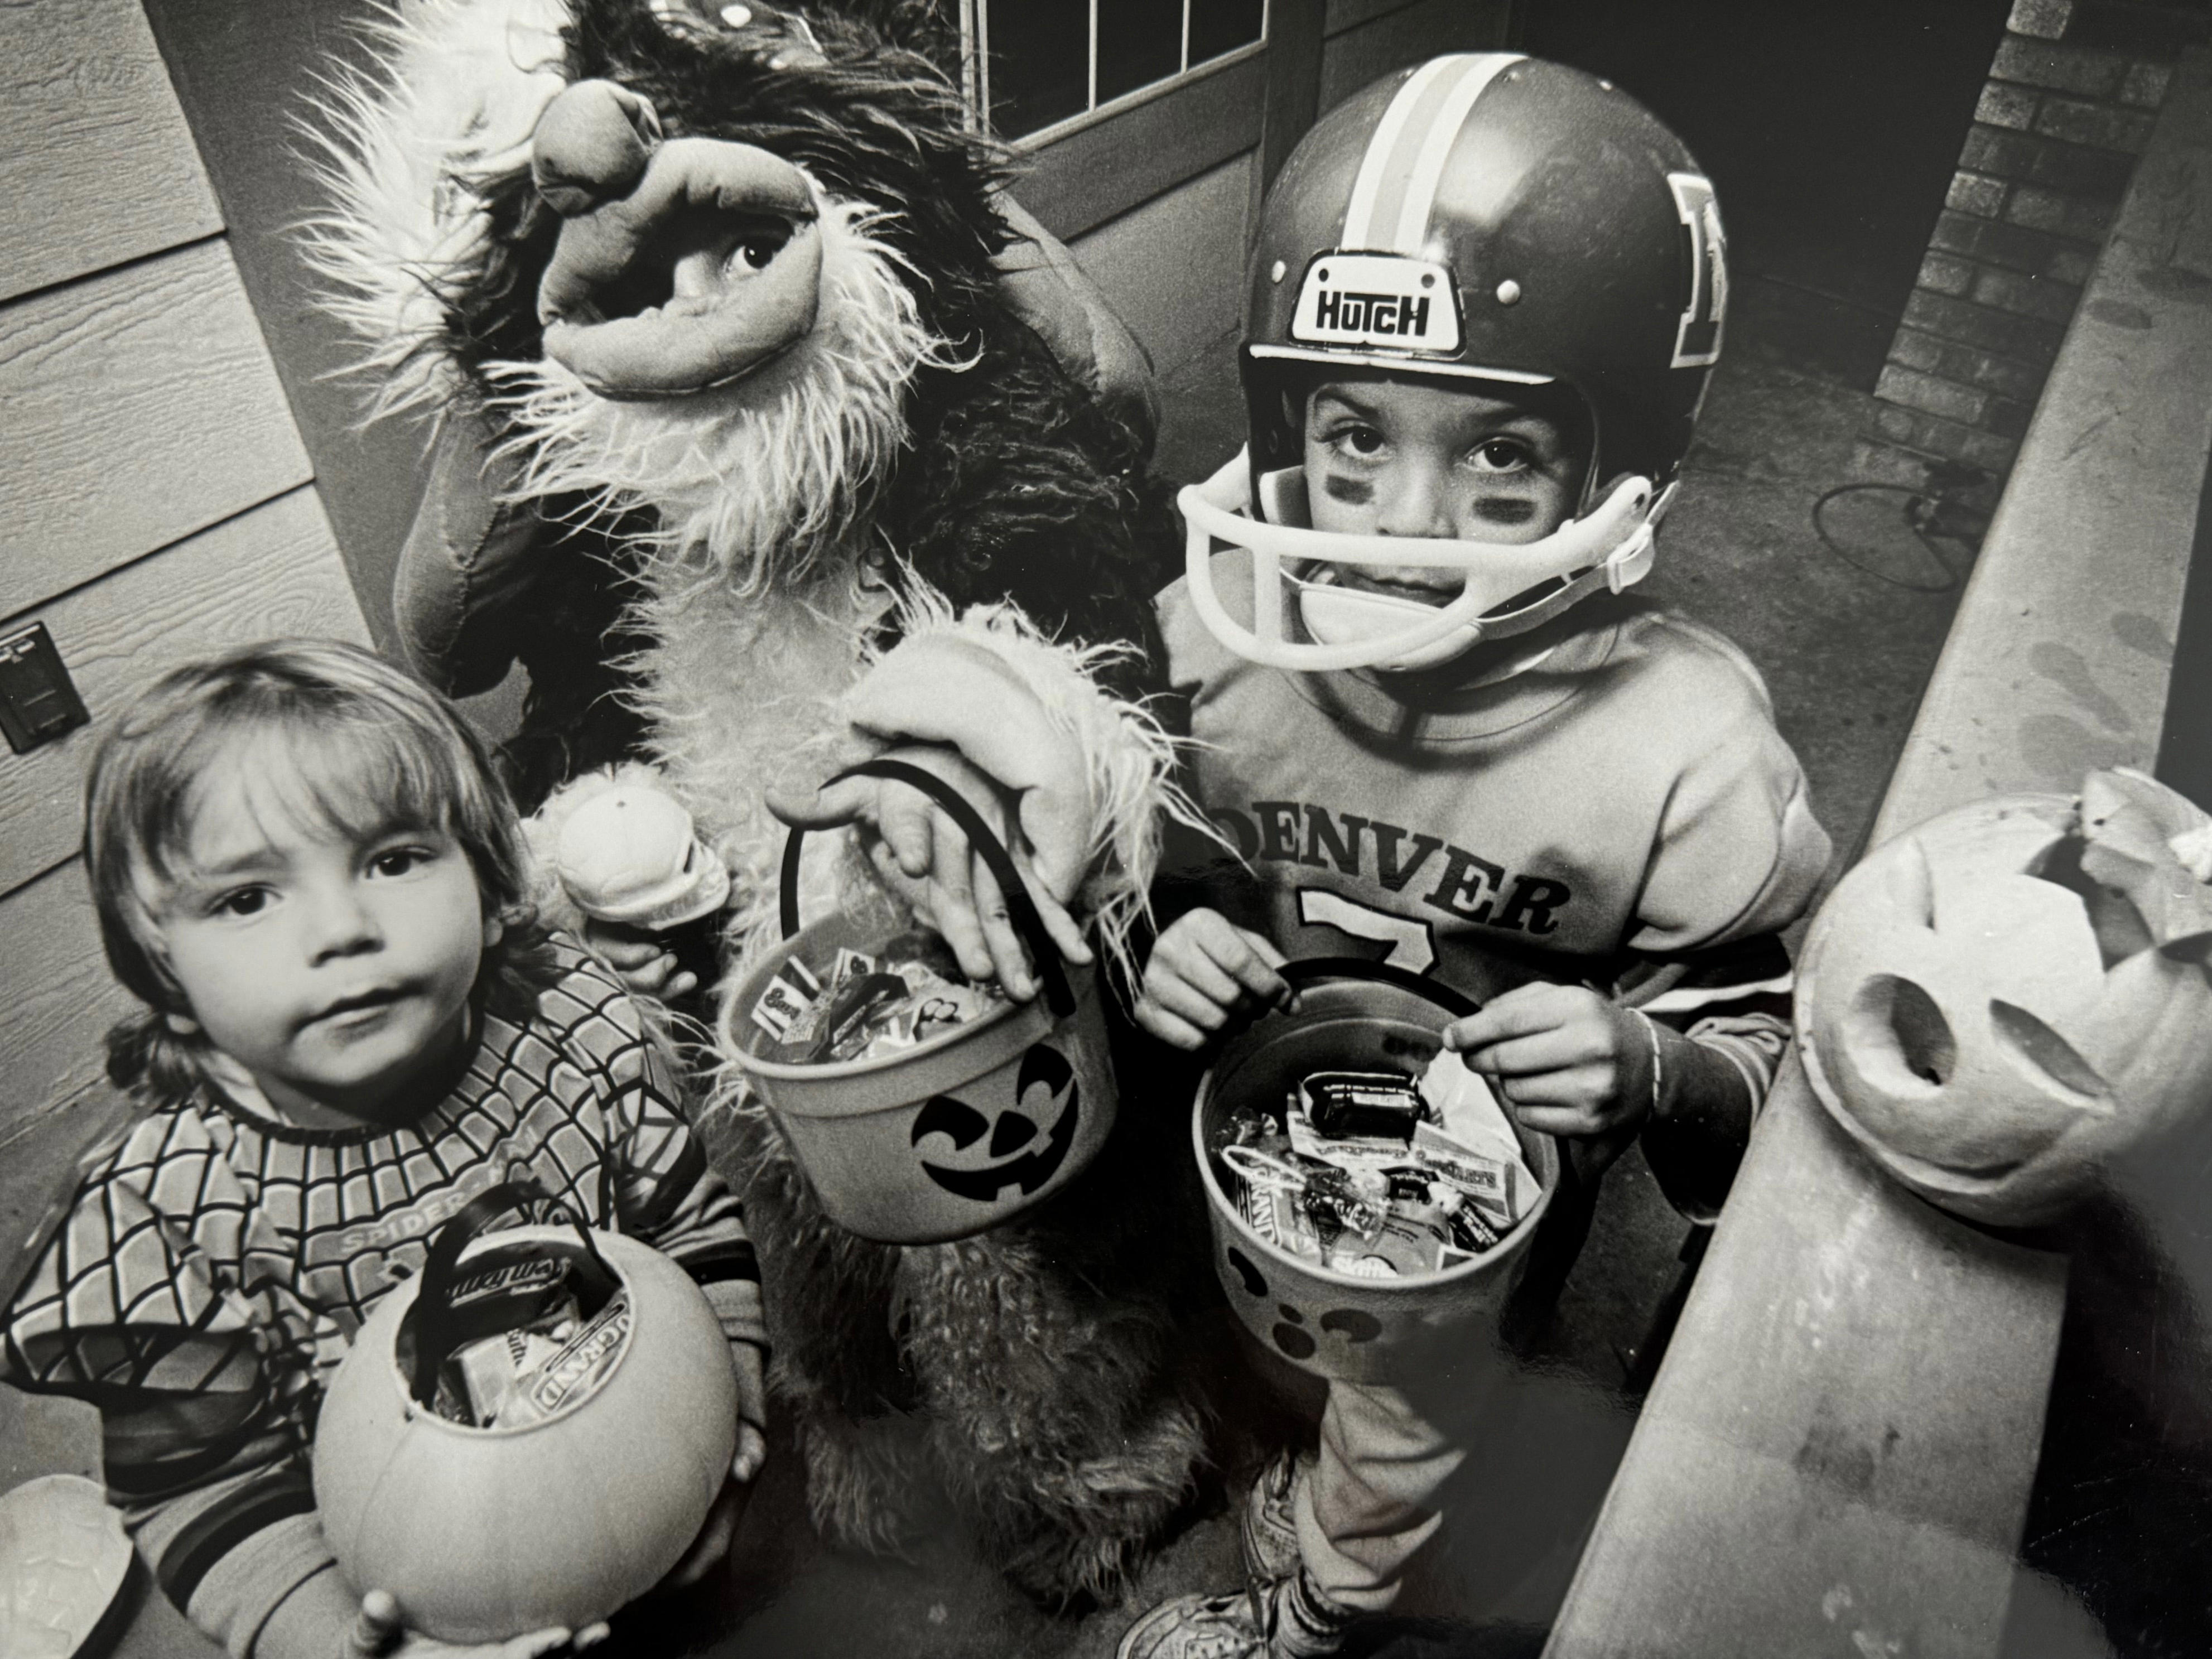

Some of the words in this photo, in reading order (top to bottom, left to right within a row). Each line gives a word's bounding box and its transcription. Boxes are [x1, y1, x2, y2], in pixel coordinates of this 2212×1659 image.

[1316, 291, 1430, 336] HUTCH
[1207, 801, 1570, 935] DENVER
[1296, 887, 1440, 976] 7
[541, 1327, 620, 1406] GRAND
